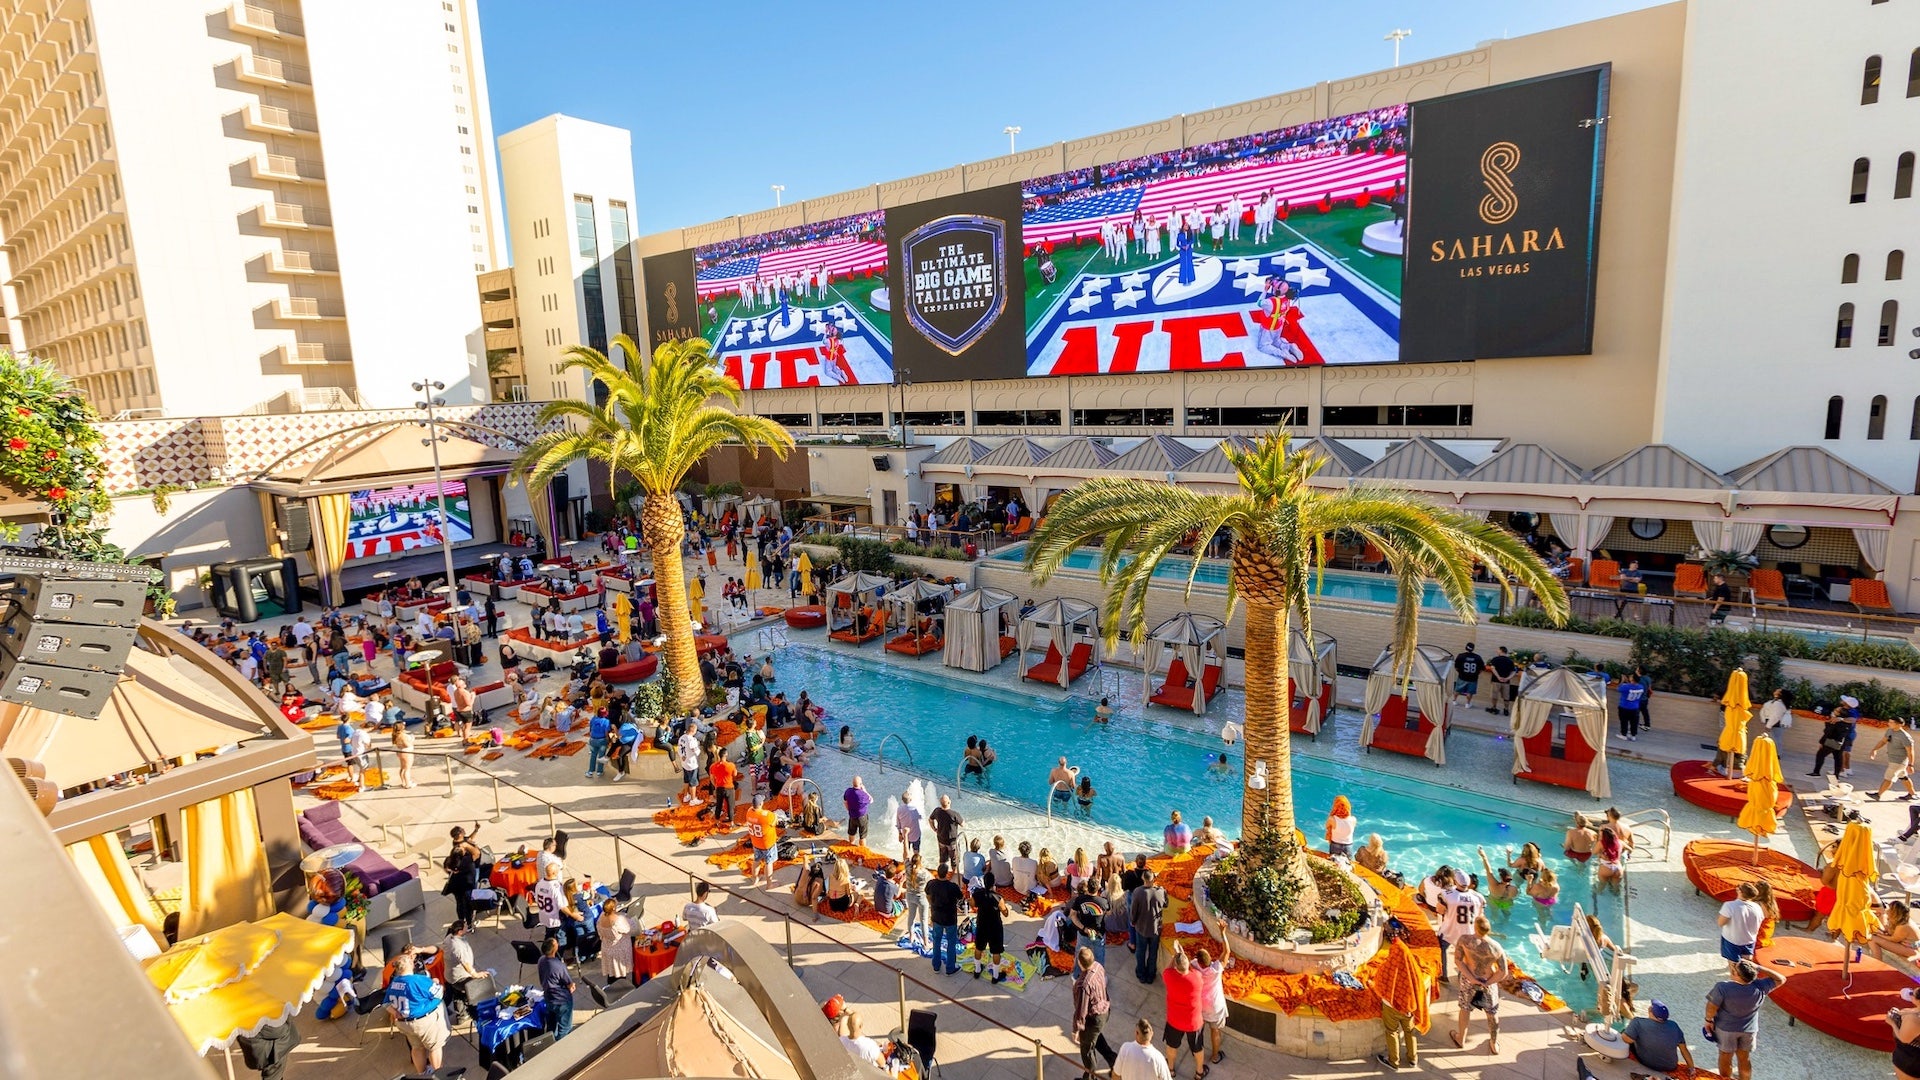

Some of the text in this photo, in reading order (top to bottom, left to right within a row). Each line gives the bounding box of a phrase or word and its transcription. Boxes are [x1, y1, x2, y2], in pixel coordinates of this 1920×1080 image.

[939, 243, 964, 257] THE
[1431, 227, 1565, 262] SAHARA
[921, 253, 984, 271] ULTIMATE
[1460, 262, 1530, 278] LAS VEGAS
[915, 264, 992, 291] BIG GAME
[916, 283, 993, 304] TAILGATE
[924, 300, 985, 313] EXPERIENCE
[656, 326, 694, 342] SAHARA
[537, 894, 554, 913] 58
